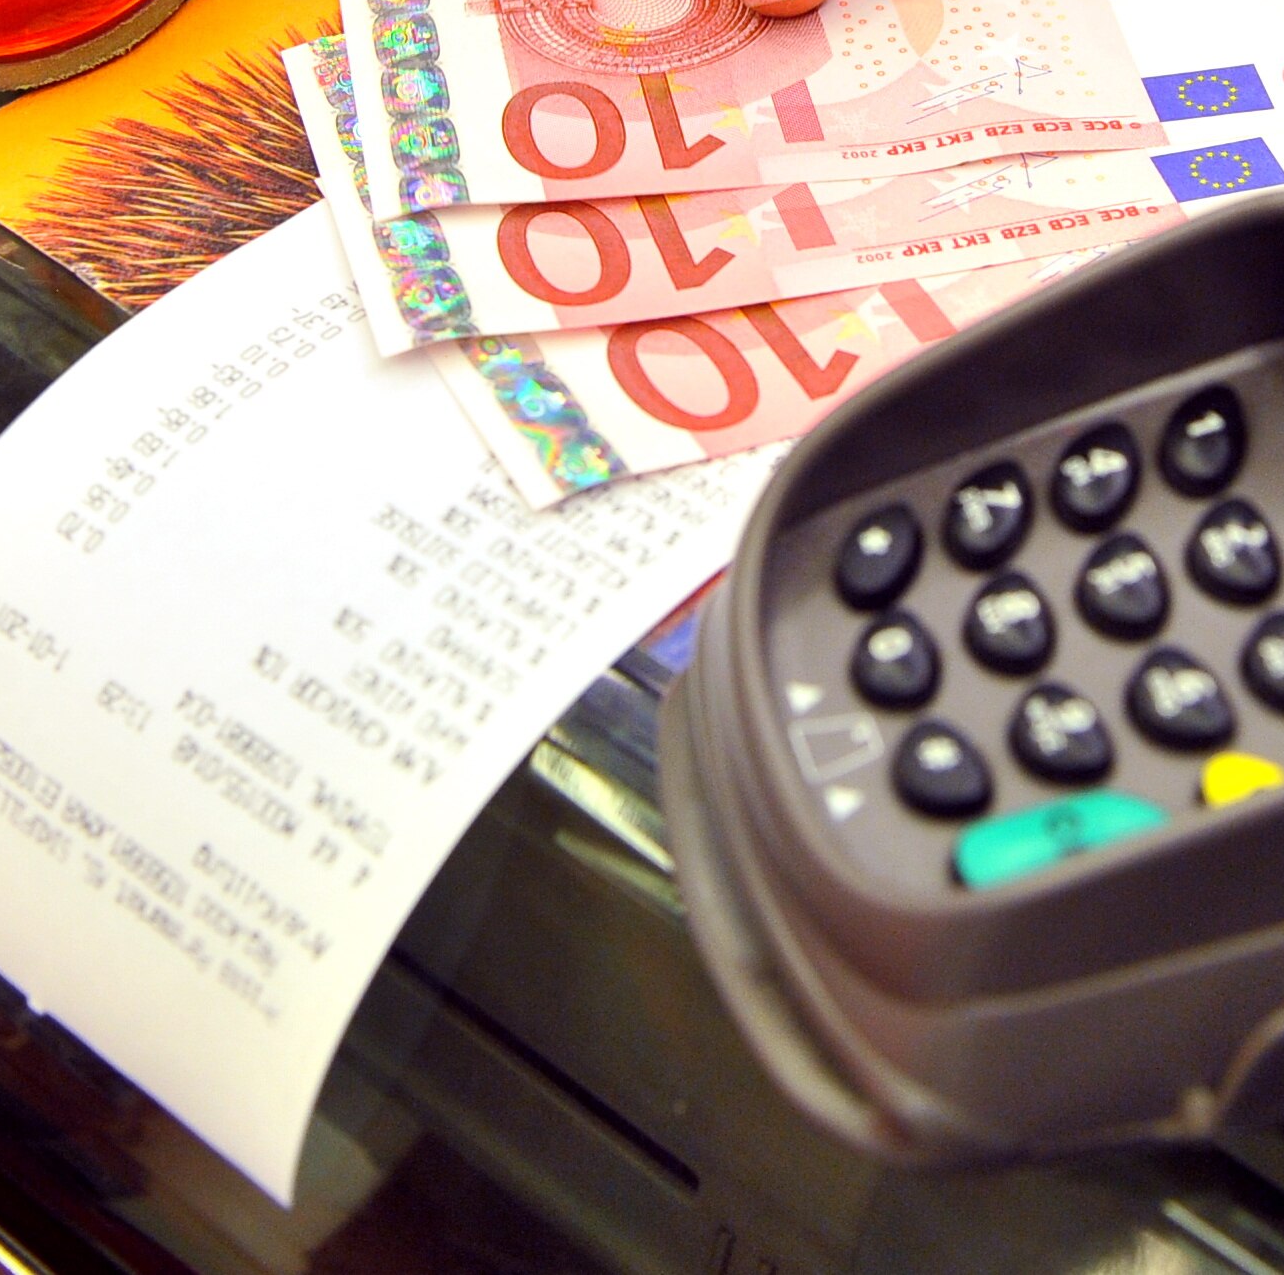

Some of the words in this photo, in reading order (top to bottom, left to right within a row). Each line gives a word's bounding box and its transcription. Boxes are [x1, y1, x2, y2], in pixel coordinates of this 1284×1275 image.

[501, 73, 727, 179] 10
[984, 123, 1024, 139] EZB
[1032, 120, 1074, 135] ECB
[1080, 118, 1123, 133] BCE
[886, 139, 928, 157] EKP
[936, 130, 979, 148] EKT
[841, 148, 879, 160] 2002
[1048, 210, 1090, 227] ECB
[1100, 204, 1142, 219] BCE
[1000, 218, 1041, 236] EZB
[947, 227, 991, 247] EKT
[497, 194, 735, 306] 10
[902, 238, 944, 257] EKP
[855, 250, 894, 264] 2002
[291, 300, 344, 348] 0.37-
[266, 316, 317, 359] 0.73
[239, 335, 291, 386] 0.10
[608, 303, 860, 430] 10
[55, 510, 106, 555] 0.70
